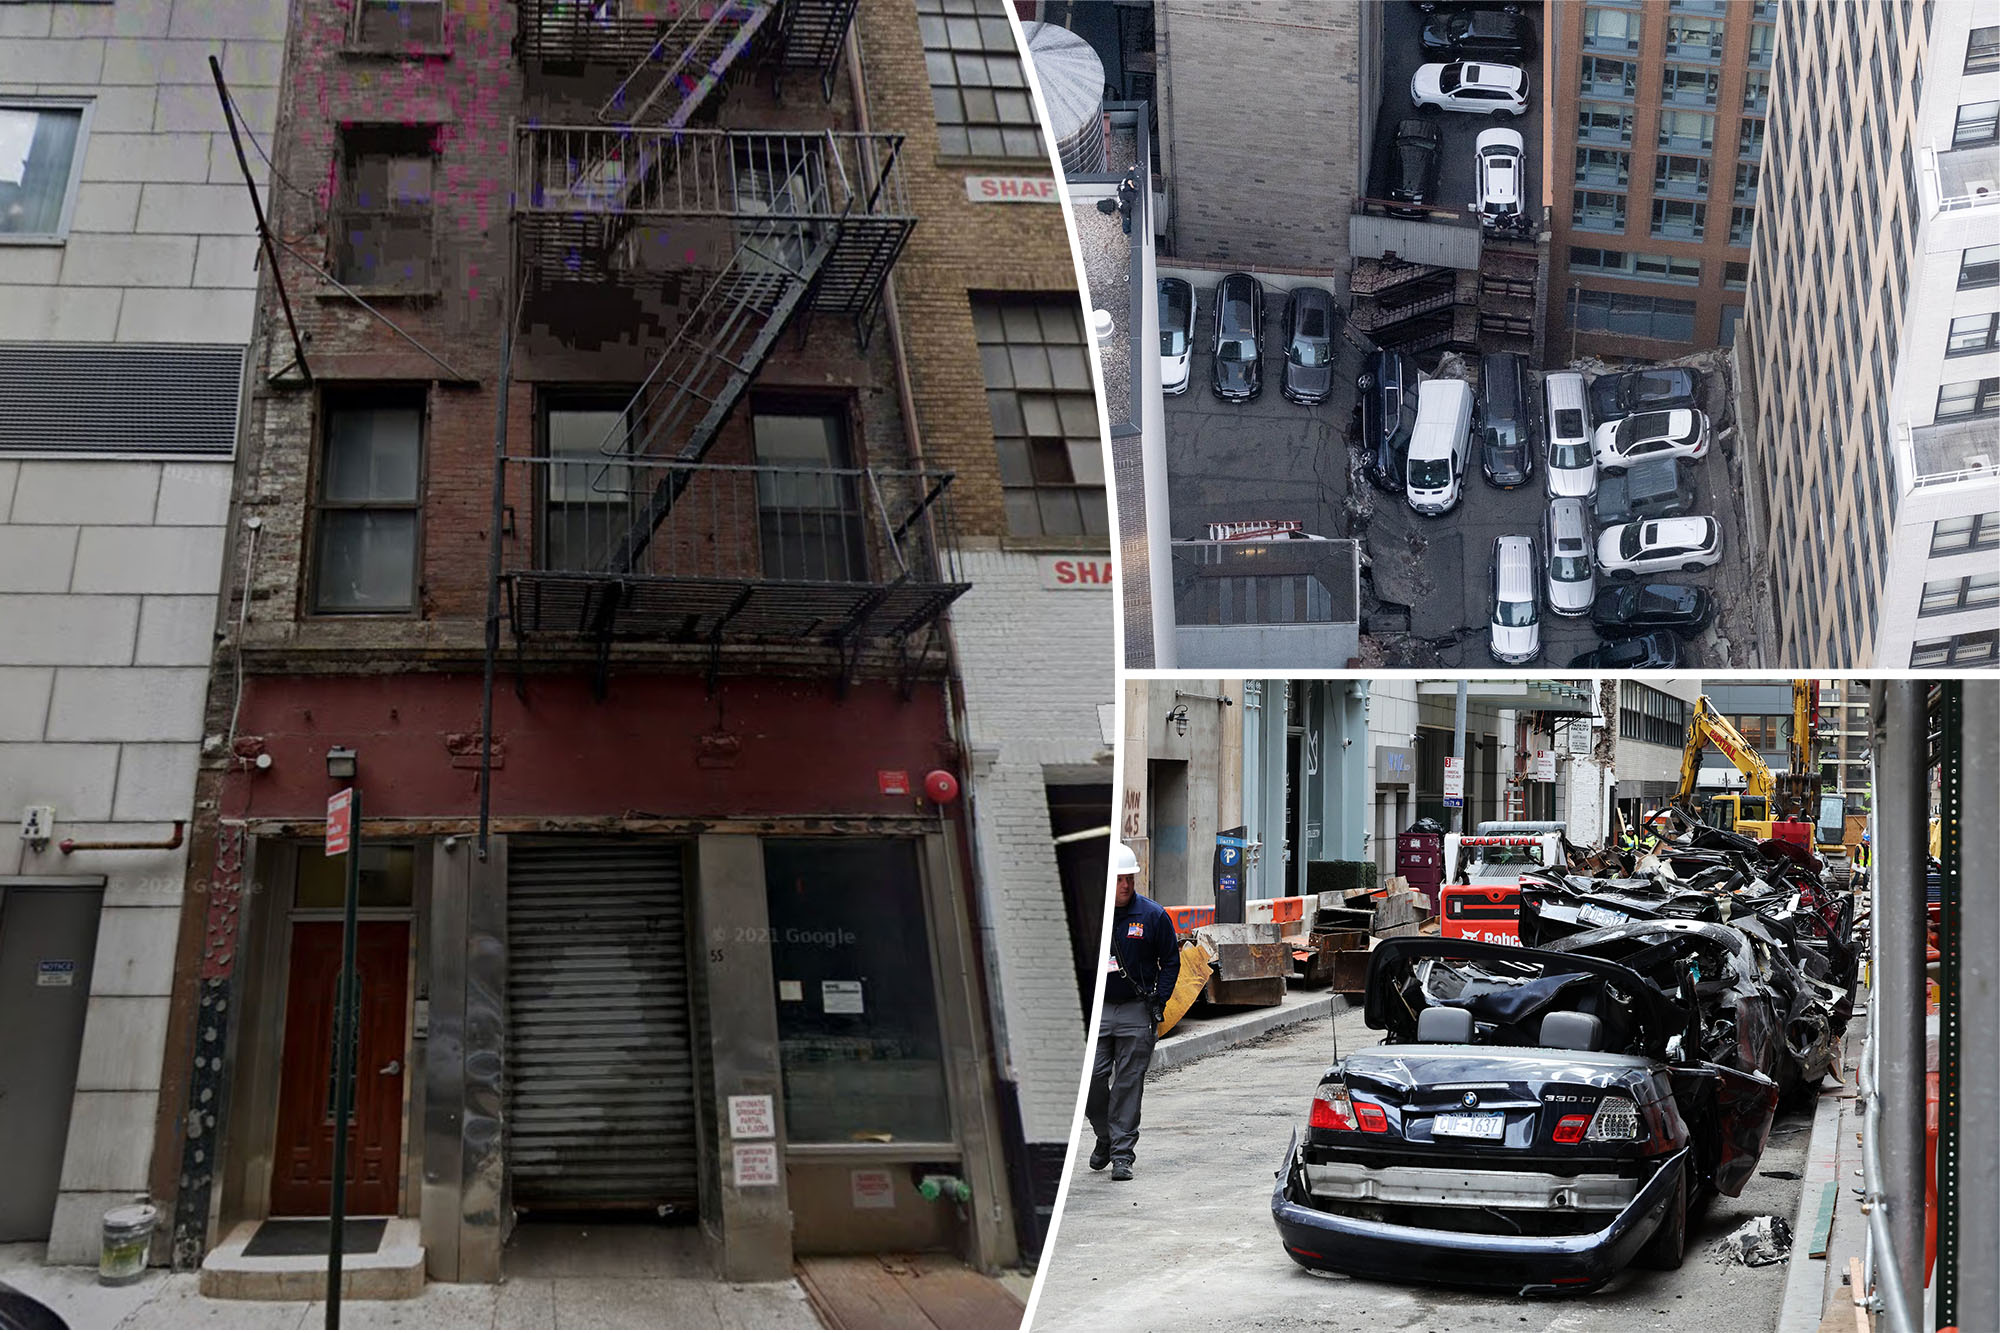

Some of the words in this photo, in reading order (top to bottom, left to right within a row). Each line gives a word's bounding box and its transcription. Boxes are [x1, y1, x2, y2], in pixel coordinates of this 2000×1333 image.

[981, 180, 1054, 197] SHAF
[1054, 561, 1113, 584] SHA
[1709, 729, 1737, 762] CAPITAL
[1124, 789, 1140, 810] ANN
[1124, 813, 1140, 837] 45
[1461, 837, 1543, 846] CAPITAL
[711, 950, 724, 962] 55
